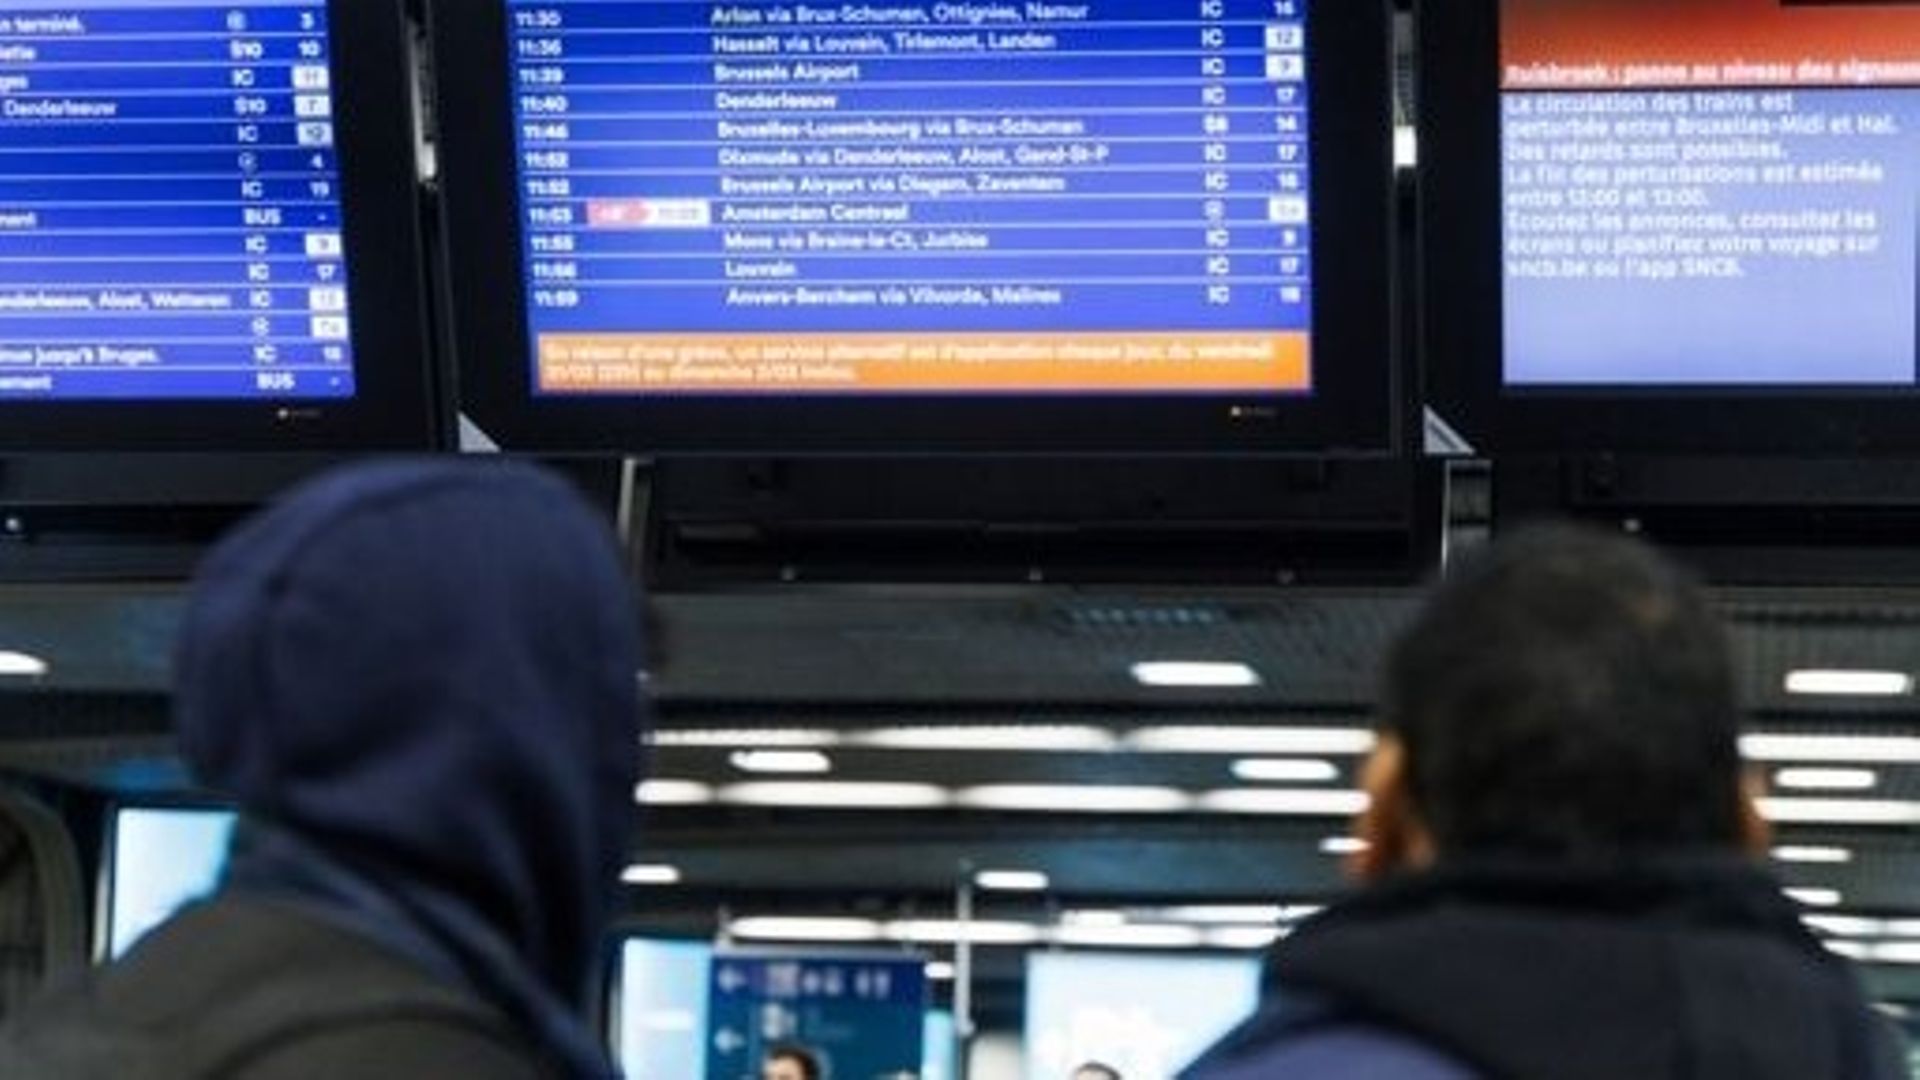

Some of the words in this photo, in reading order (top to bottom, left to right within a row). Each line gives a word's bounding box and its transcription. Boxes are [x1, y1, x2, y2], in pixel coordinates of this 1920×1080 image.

[766, 7, 791, 21] via
[933, 3, 1023, 23] Ottignies,
[1027, 3, 1089, 18] Namur
[1201, 1, 1223, 17] IC
[515, 11, 562, 27] 11:30
[712, 34, 780, 52] Hasselt
[785, 36, 810, 52] via
[814, 34, 889, 53] Louvain,
[894, 32, 985, 51] Tirlemont,
[988, 32, 1057, 49] Landen
[1201, 29, 1224, 47] IC
[713, 63, 789, 82] Brussels
[793, 62, 859, 83] Airport
[1202, 58, 1225, 75] IC
[232, 69, 254, 86] IC
[520, 96, 567, 112] 11:40
[715, 92, 838, 109] Denderleeuw
[1202, 87, 1226, 104] IC
[1507, 95, 1532, 112] La
[1536, 94, 1646, 112] circulation
[1652, 93, 1690, 111] des
[1694, 93, 1755, 111] trains
[1760, 94, 1794, 111] est
[237, 126, 259, 142] IC
[926, 121, 950, 135] via
[1506, 117, 1609, 139] perturbée
[1614, 119, 1671, 136] entre
[1676, 116, 1825, 136] Bruxelles-Midi
[1830, 118, 1854, 134] et
[805, 149, 829, 165] via
[1204, 144, 1226, 161] IC
[1508, 142, 1544, 160] Des
[1550, 141, 1624, 161] retards
[1629, 142, 1677, 160] sont
[1682, 141, 1788, 162] possibles.
[1205, 172, 1228, 189] IC
[1509, 166, 1533, 183] La
[1537, 165, 1568, 183] fin
[1572, 164, 1609, 183] des
[1614, 164, 1757, 185] perturbations
[1763, 164, 1795, 181] est
[1800, 162, 1883, 181] estimée
[242, 181, 264, 198] IC
[721, 176, 794, 193] Brussels
[799, 176, 866, 196] Airport
[870, 176, 895, 191] via
[977, 174, 1065, 191] Zaventem
[1507, 189, 1563, 206] entre
[1625, 189, 1647, 205] et
[244, 208, 281, 225] BUS
[722, 205, 826, 222] Amsterdam
[830, 203, 909, 220] Centraal
[1593, 211, 1622, 229] les
[1629, 212, 1733, 231] annonces,
[1739, 210, 1839, 229] consultez
[1845, 210, 1875, 228] les
[246, 236, 267, 252] IC
[723, 232, 773, 248] Mons
[778, 233, 803, 248] via
[1206, 230, 1229, 246] IC
[1581, 238, 1608, 254] ou
[1614, 234, 1705, 257] planifiez
[1709, 236, 1763, 253] votre
[1768, 238, 1839, 256] voyage
[249, 263, 270, 280] IC
[725, 260, 796, 277] Louvain
[1206, 258, 1229, 274] IC
[1507, 258, 1585, 277] sncb.be
[1594, 262, 1619, 277] ou
[251, 290, 272, 307] IC
[726, 288, 875, 306] Anvers-Berchem
[879, 289, 906, 304] via
[909, 287, 989, 306] Vilvorde,
[993, 287, 1062, 304] Malines
[1208, 287, 1230, 303] IC
[255, 346, 277, 363] IC
[256, 373, 295, 390] BUS
